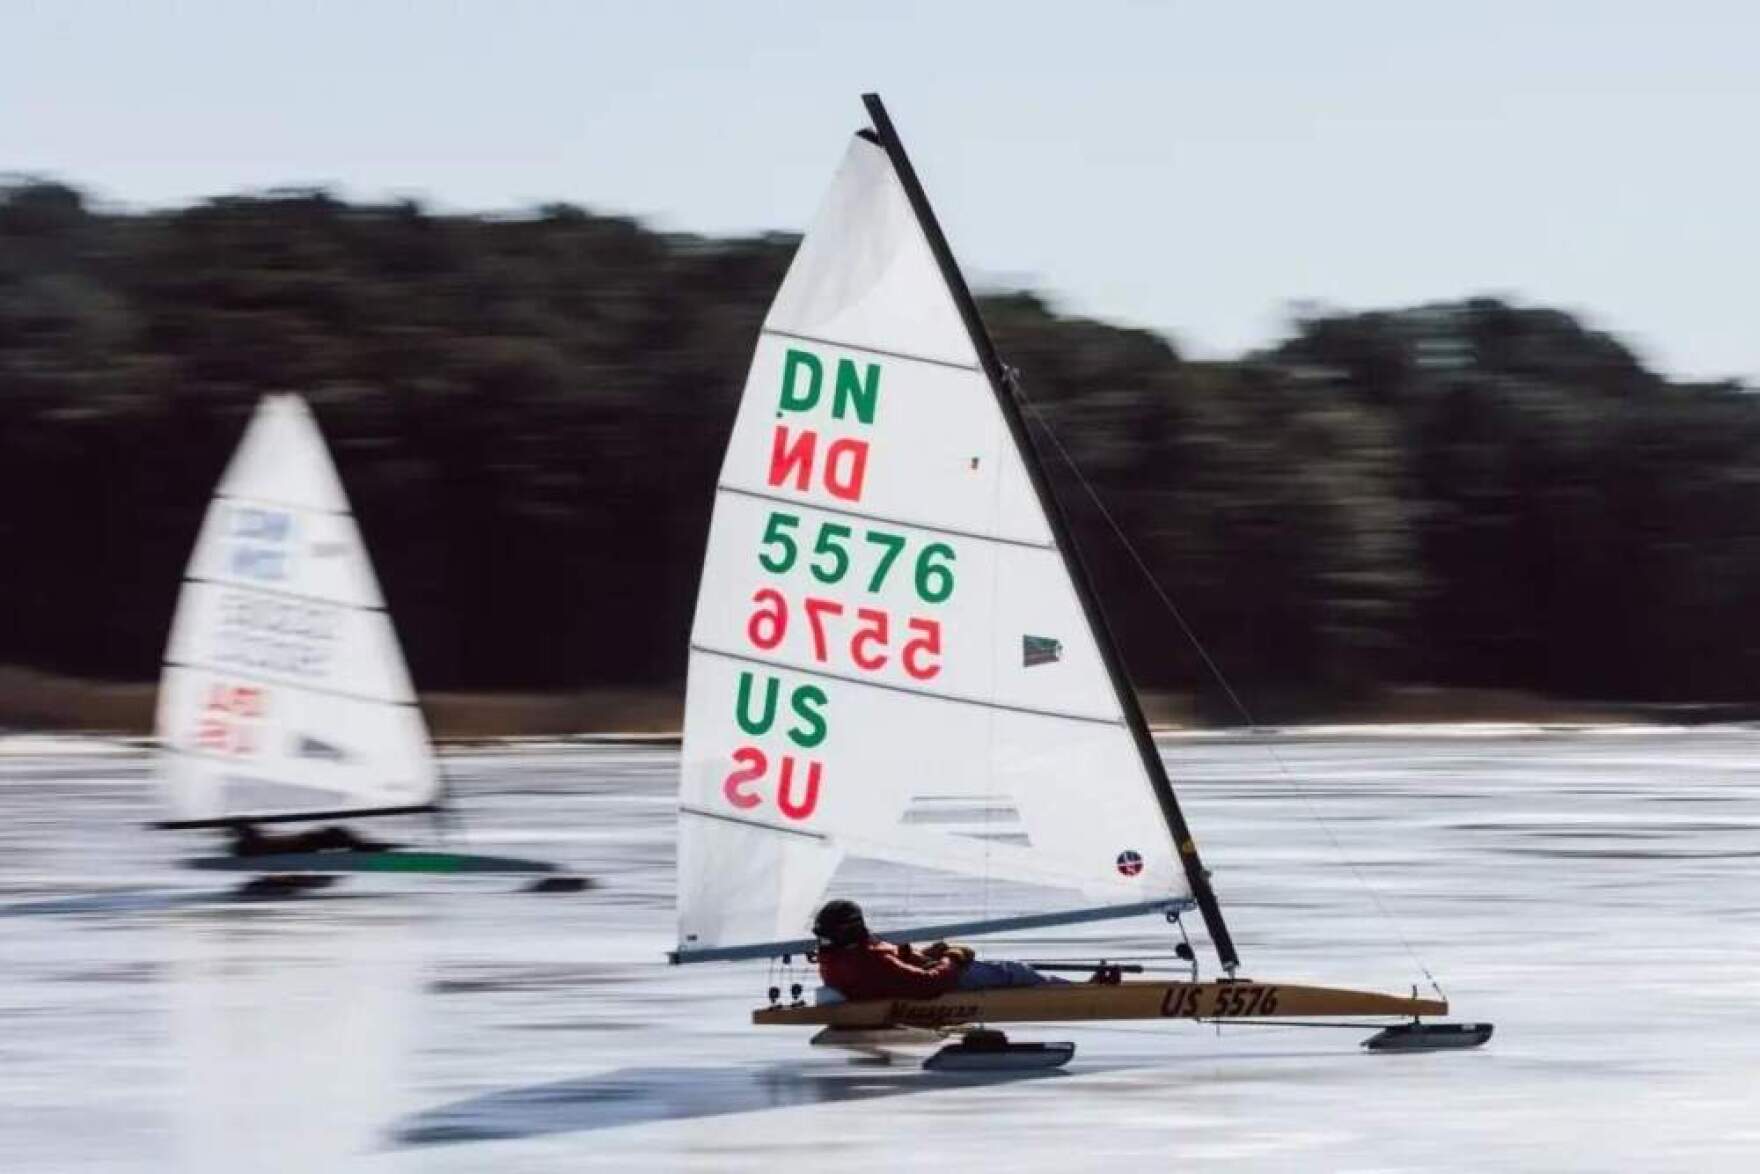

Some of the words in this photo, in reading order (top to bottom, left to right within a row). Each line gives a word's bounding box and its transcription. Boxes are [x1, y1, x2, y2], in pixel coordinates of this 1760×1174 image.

[779, 348, 881, 424] DN
[758, 511, 955, 603] 5576
[735, 671, 827, 748] US
[1160, 986, 1203, 1016] US
[1213, 986, 1279, 1016] 5576
